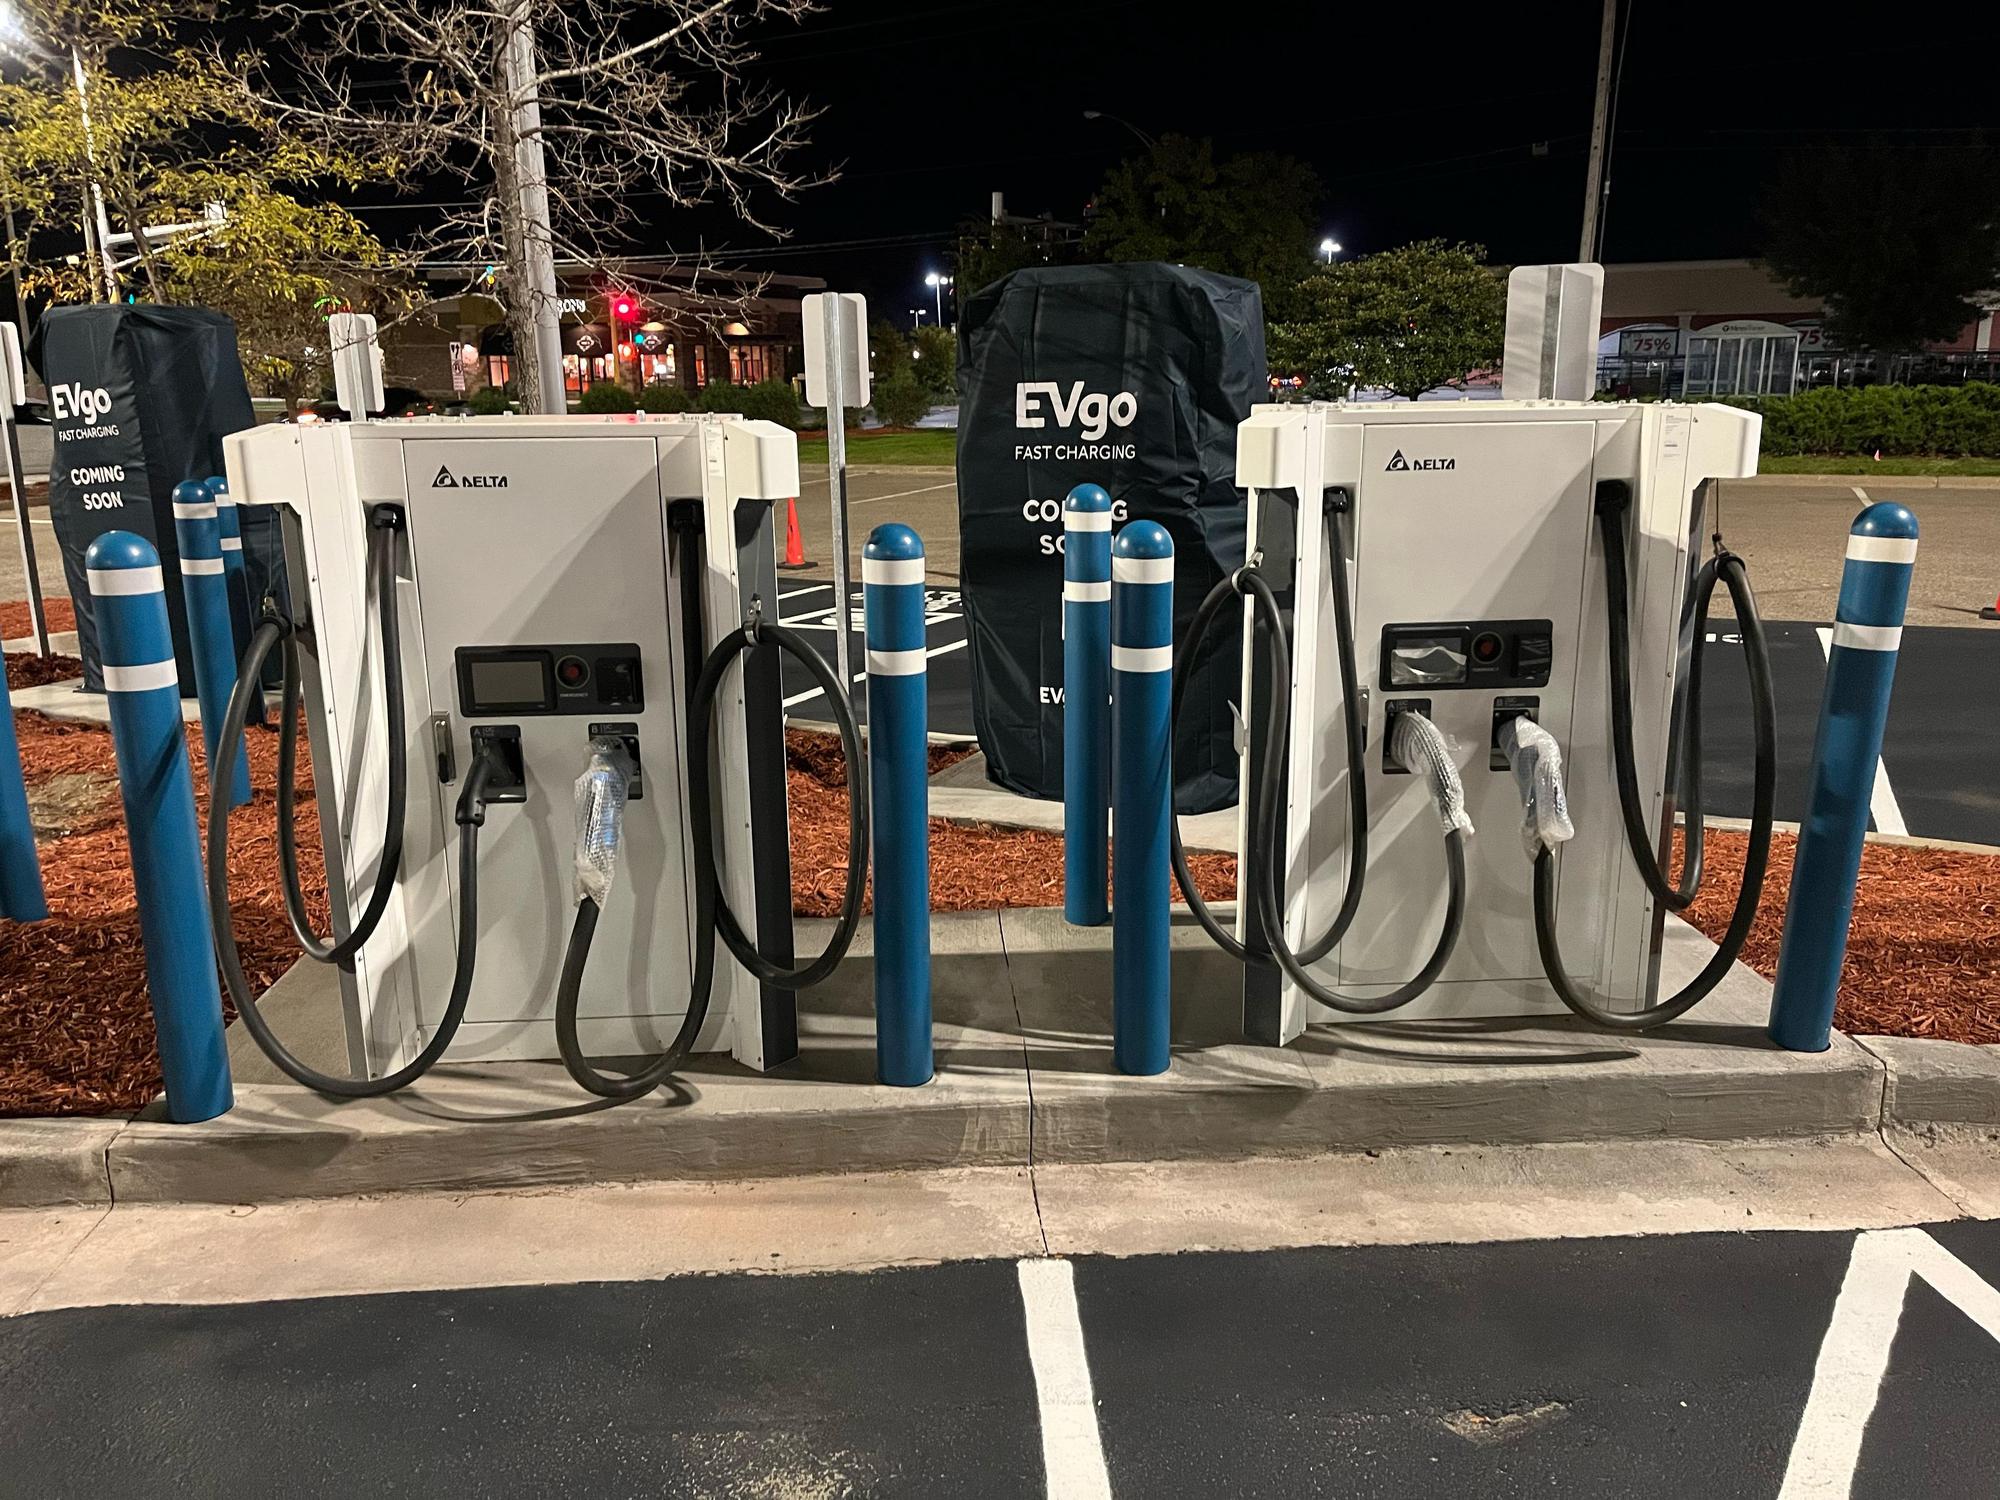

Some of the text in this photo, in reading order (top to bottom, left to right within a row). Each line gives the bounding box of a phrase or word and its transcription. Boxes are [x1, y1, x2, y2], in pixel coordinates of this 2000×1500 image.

[1634, 336, 1672, 352] 75%
[51, 382, 112, 425] EVgo
[1016, 381, 1138, 441] EVgo
[59, 424, 119, 442] FAST CHARGING
[1015, 444, 1136, 460] FAST CHARGING
[1413, 459, 1455, 471] DELTA
[70, 465, 125, 486] COMING
[462, 476, 508, 488] DELTA
[83, 491, 124, 510] SOON
[1023, 500, 1128, 522] COG
